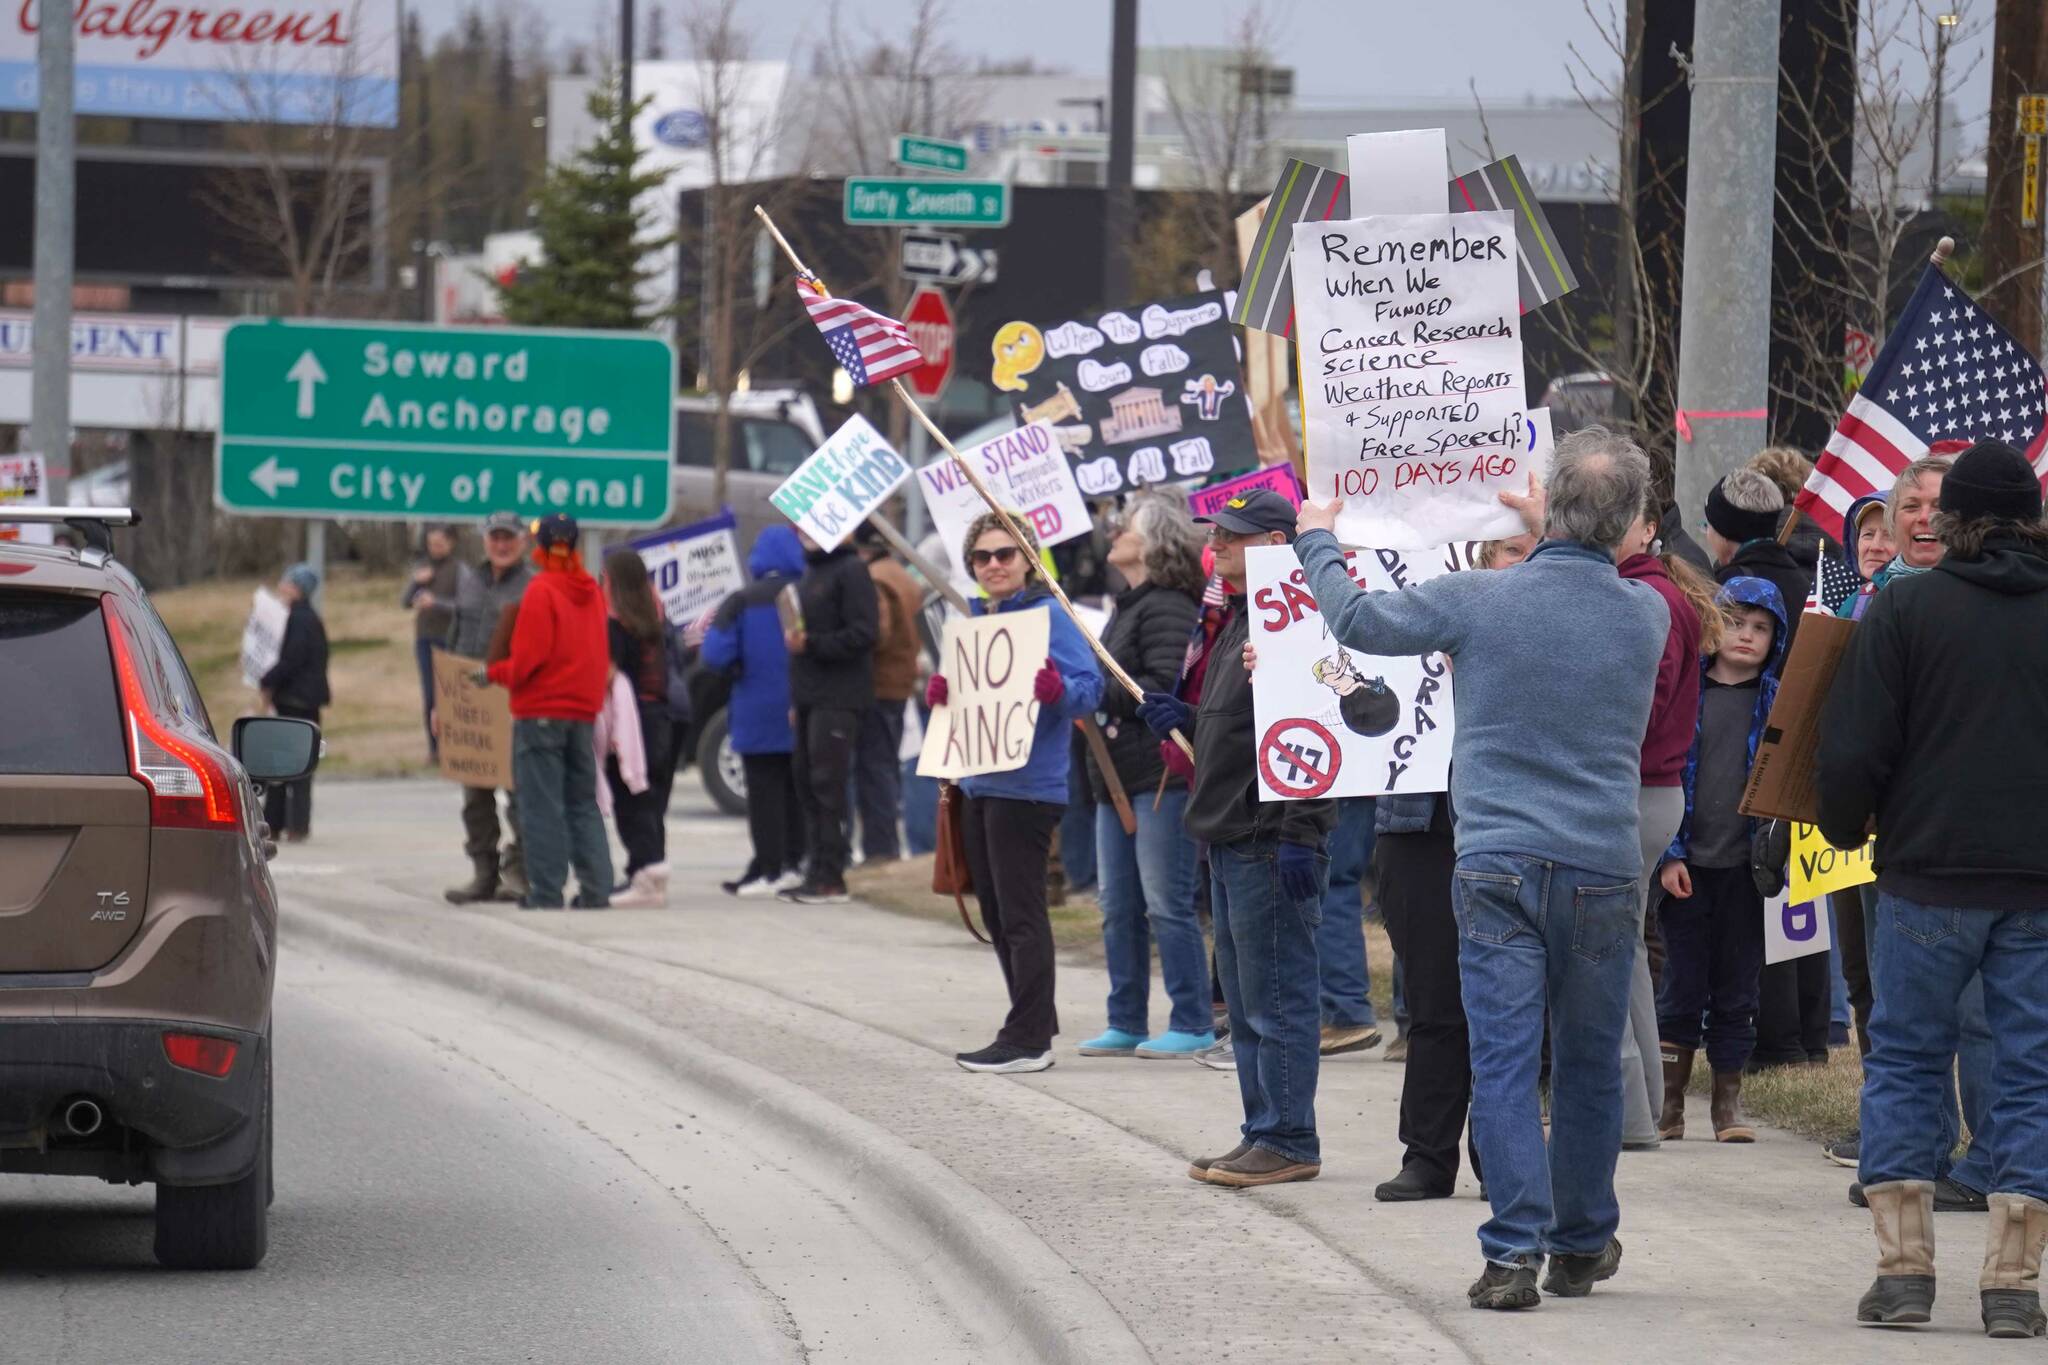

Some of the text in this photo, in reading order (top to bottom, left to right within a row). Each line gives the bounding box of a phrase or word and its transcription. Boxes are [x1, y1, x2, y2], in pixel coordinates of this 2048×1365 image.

[1406, 268, 1440, 293] We
[908, 322, 951, 364] STOP
[1048, 305, 1217, 353] When The Supreme
[363, 342, 529, 382] Seward
[1080, 353, 1186, 388] Court Falls
[361, 393, 611, 444] Anchorage
[982, 425, 1050, 475] STAND
[1084, 440, 1209, 487] We All Fall
[328, 463, 645, 508] City of Kenai
[773, 456, 842, 522] HAVE
[1334, 455, 1517, 499] 100 DAYS AGO
[1255, 551, 1367, 632] SAE
[956, 627, 1014, 694] NO
[1276, 742, 1323, 784] 47
[91, 911, 126, 920] AWD
[97, 892, 129, 905] T6
